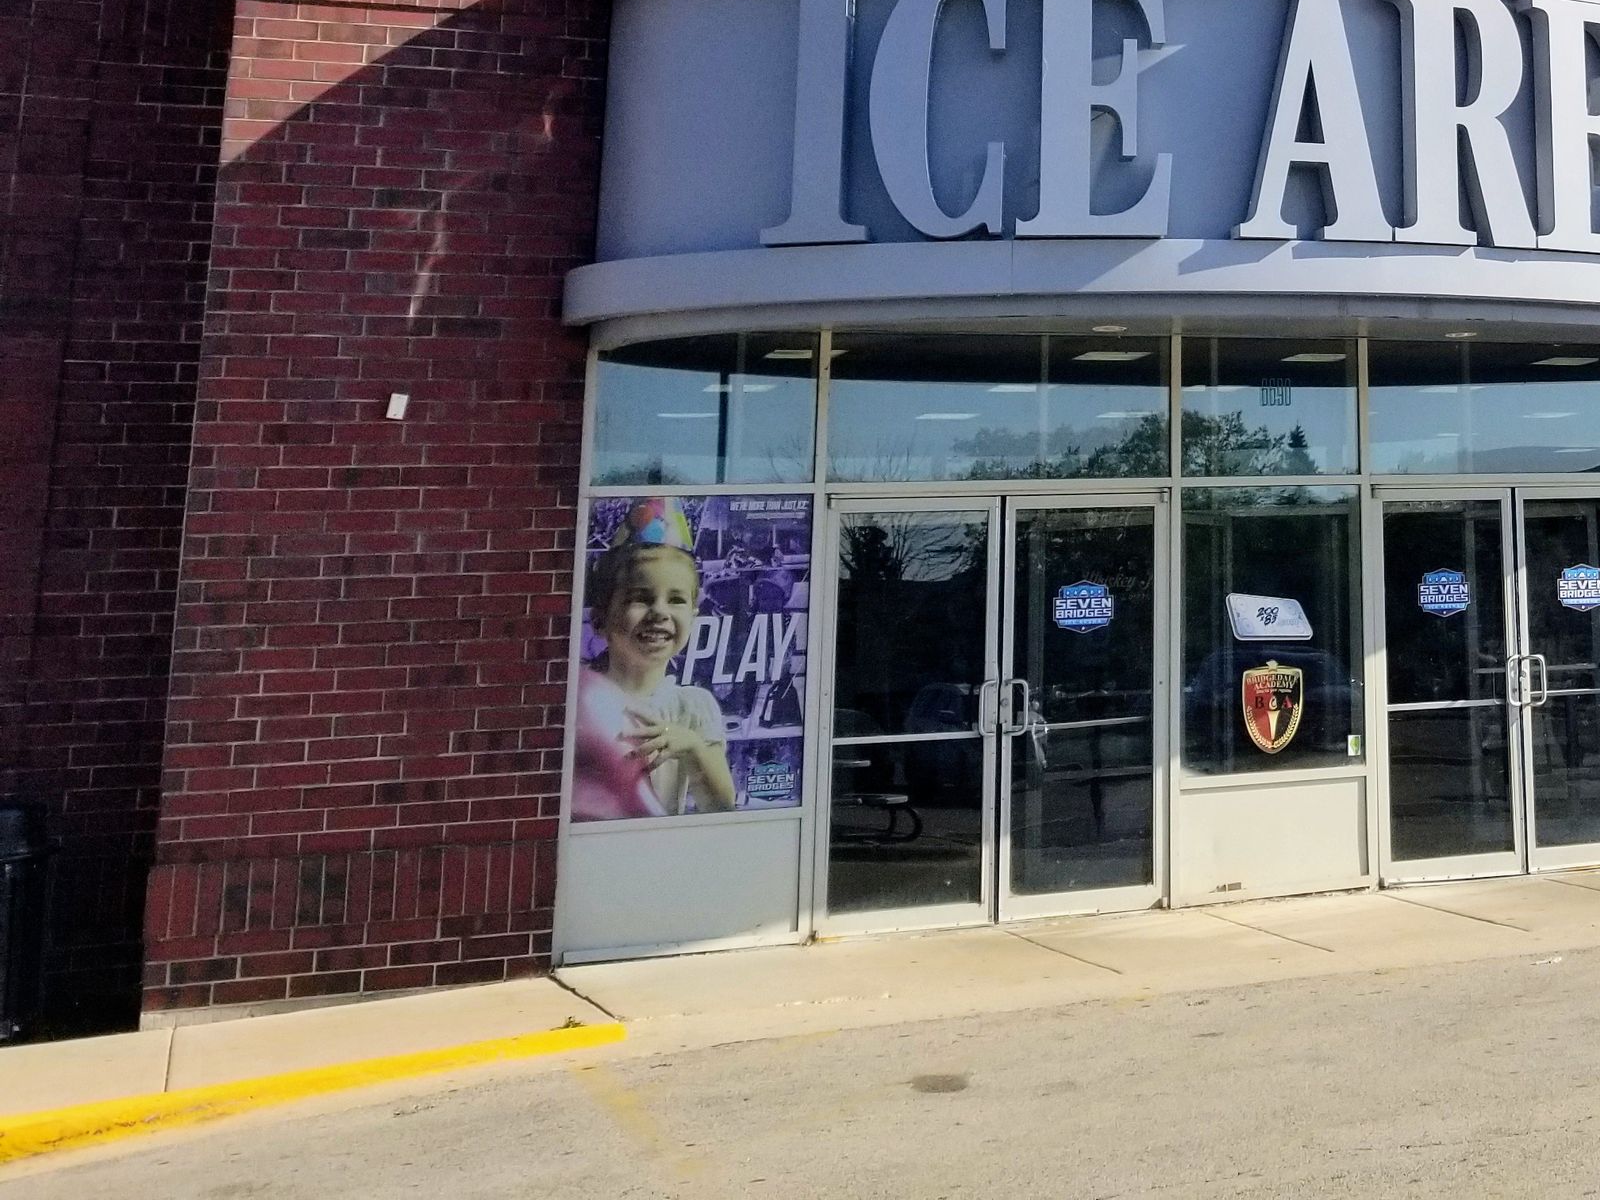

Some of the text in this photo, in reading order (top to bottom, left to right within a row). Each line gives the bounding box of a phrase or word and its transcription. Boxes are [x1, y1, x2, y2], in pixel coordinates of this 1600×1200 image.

[1420, 585, 1468, 595] SEVEN
[1056, 598, 1111, 609] SEVEN
[1420, 594, 1468, 603] BRIDGES
[1056, 608, 1112, 618] BRIDGES
[1256, 606, 1279, 618] 200
[681, 612, 800, 685] PLAY
[1254, 681, 1294, 689] ACADEMY
[748, 774, 795, 785] SEVEN
